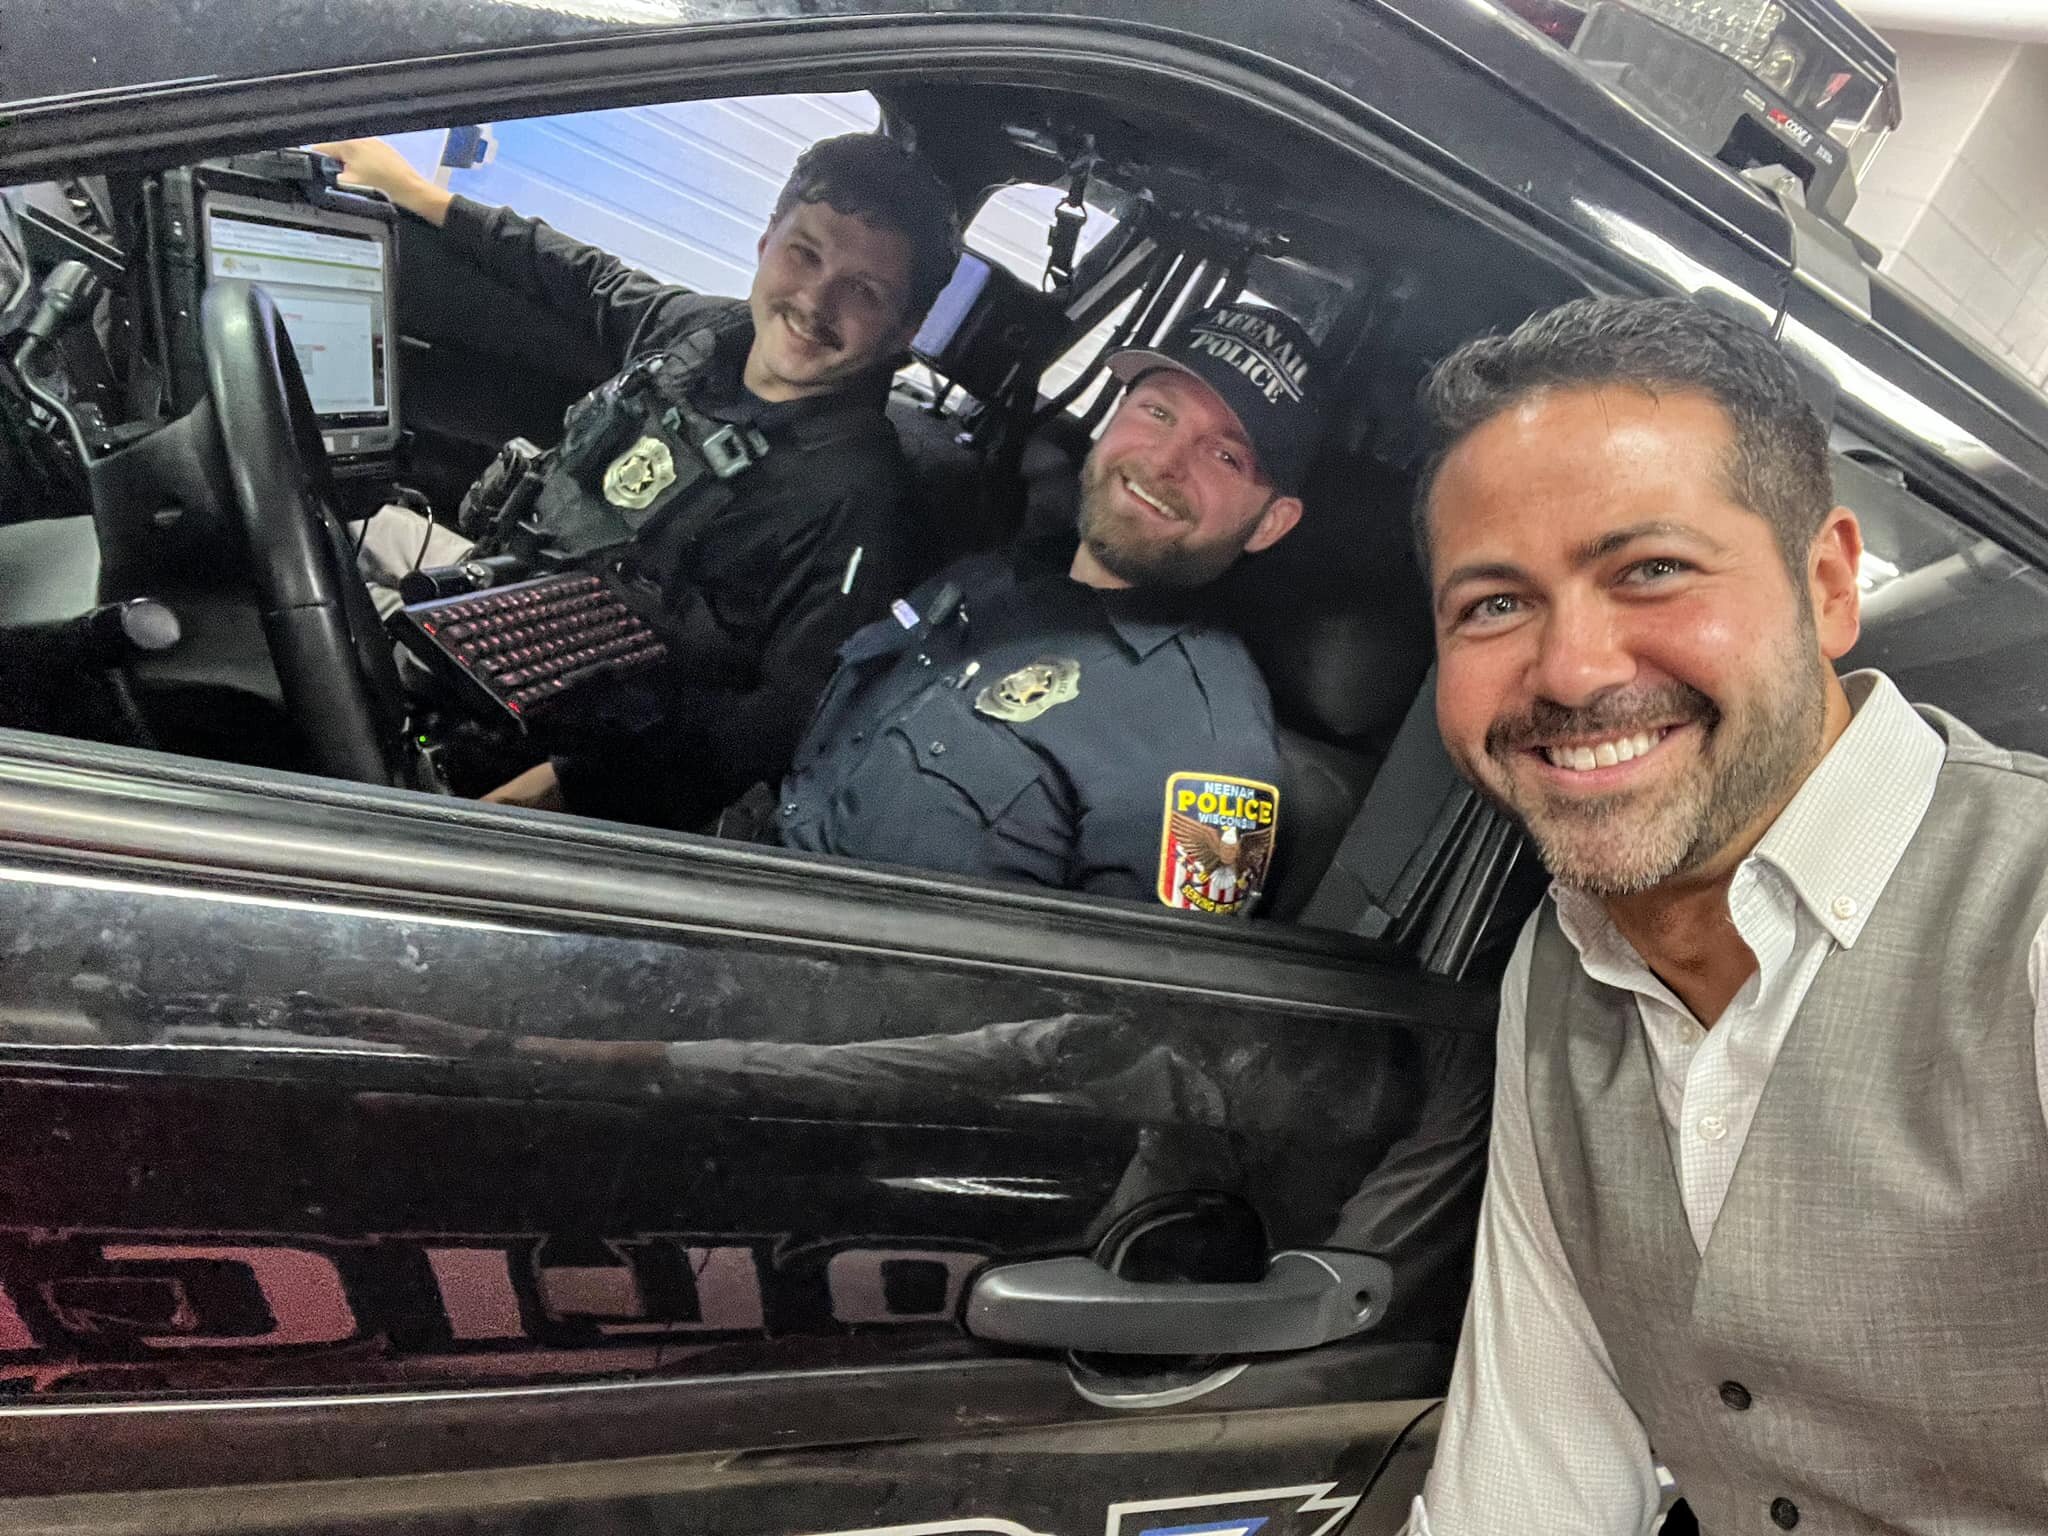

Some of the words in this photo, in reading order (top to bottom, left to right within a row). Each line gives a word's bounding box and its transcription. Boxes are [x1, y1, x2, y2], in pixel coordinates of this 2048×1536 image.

[1189, 333, 1284, 404] POLICE
[1177, 789, 1272, 824] POLICE
[1204, 782, 1255, 799] NEENAH
